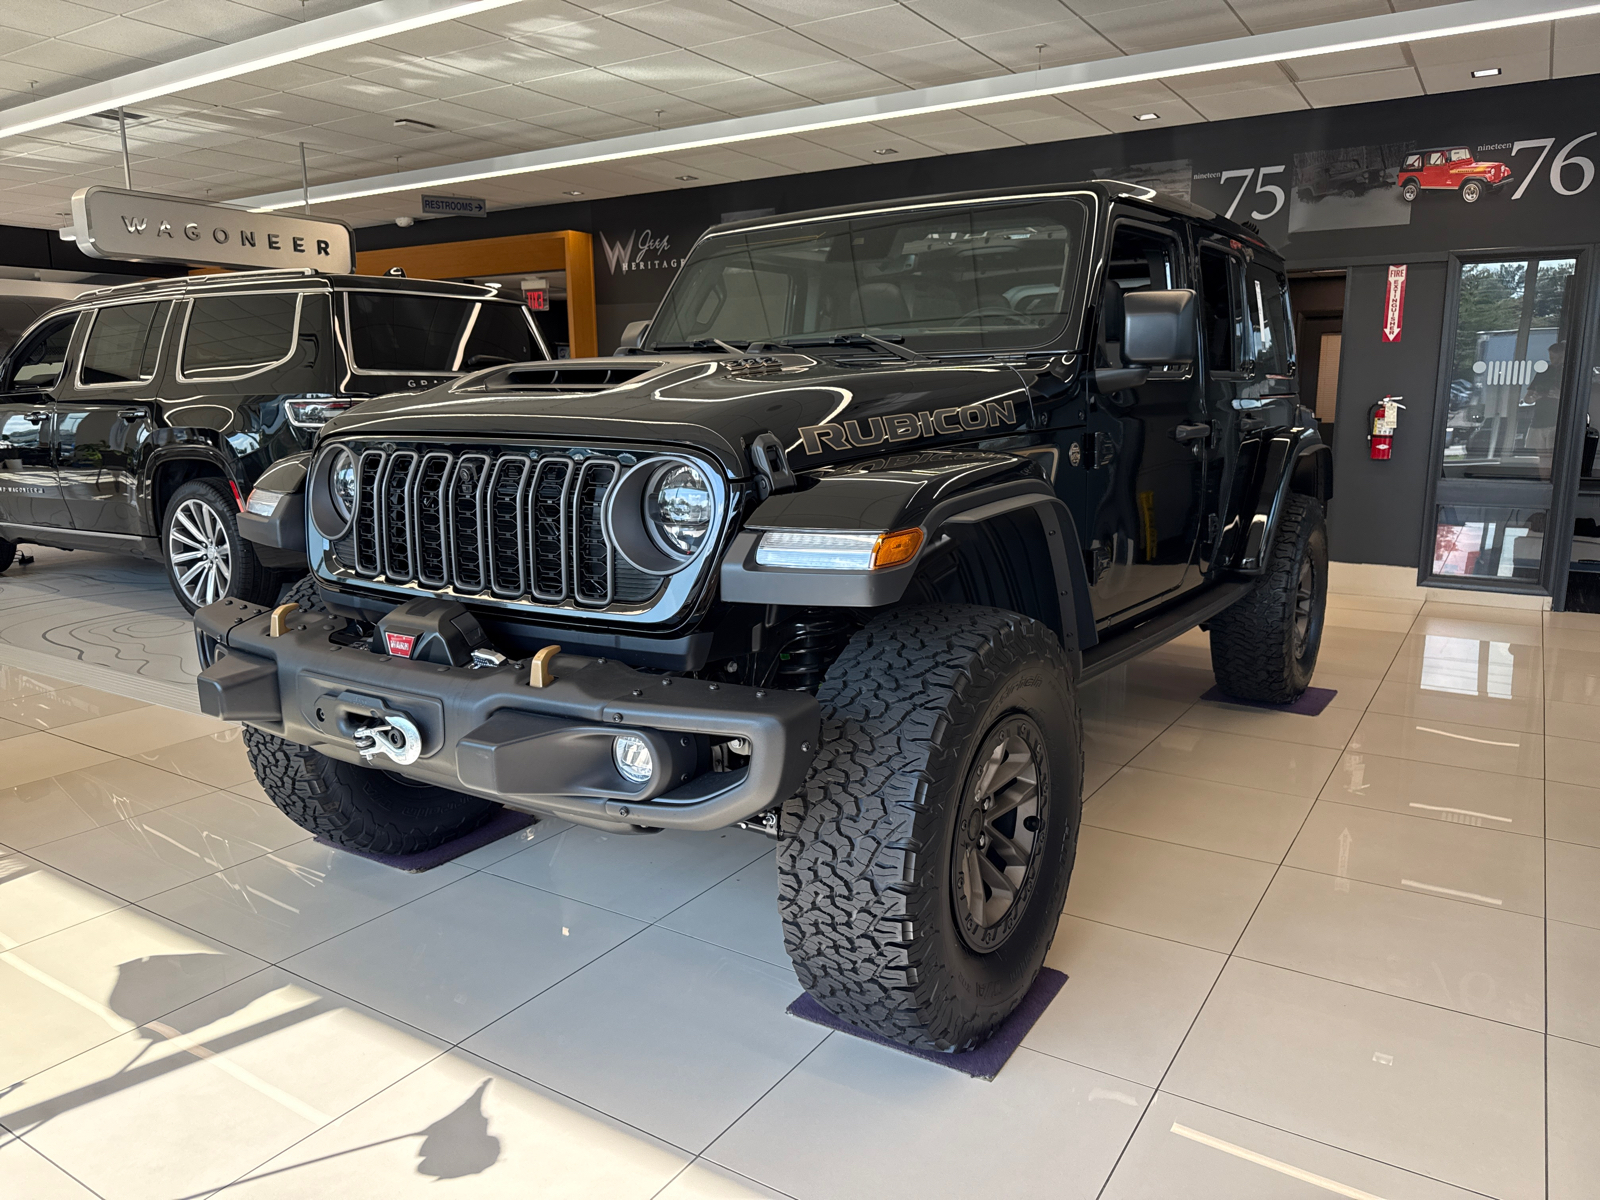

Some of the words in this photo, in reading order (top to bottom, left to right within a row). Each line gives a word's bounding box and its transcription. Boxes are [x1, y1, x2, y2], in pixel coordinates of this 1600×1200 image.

[1477, 142, 1512, 152] nineteen
[1510, 131, 1598, 201] 76
[424, 200, 473, 212] RESTROOMS
[1193, 172, 1221, 180] nineteen
[1220, 164, 1286, 221] 75
[121, 215, 331, 256] WAGONEER
[636, 229, 671, 263] Jeep
[1390, 269, 1405, 278] FIRE
[1388, 279, 1399, 336] EXTINGUISHER
[798, 400, 1017, 455] RUBICON
